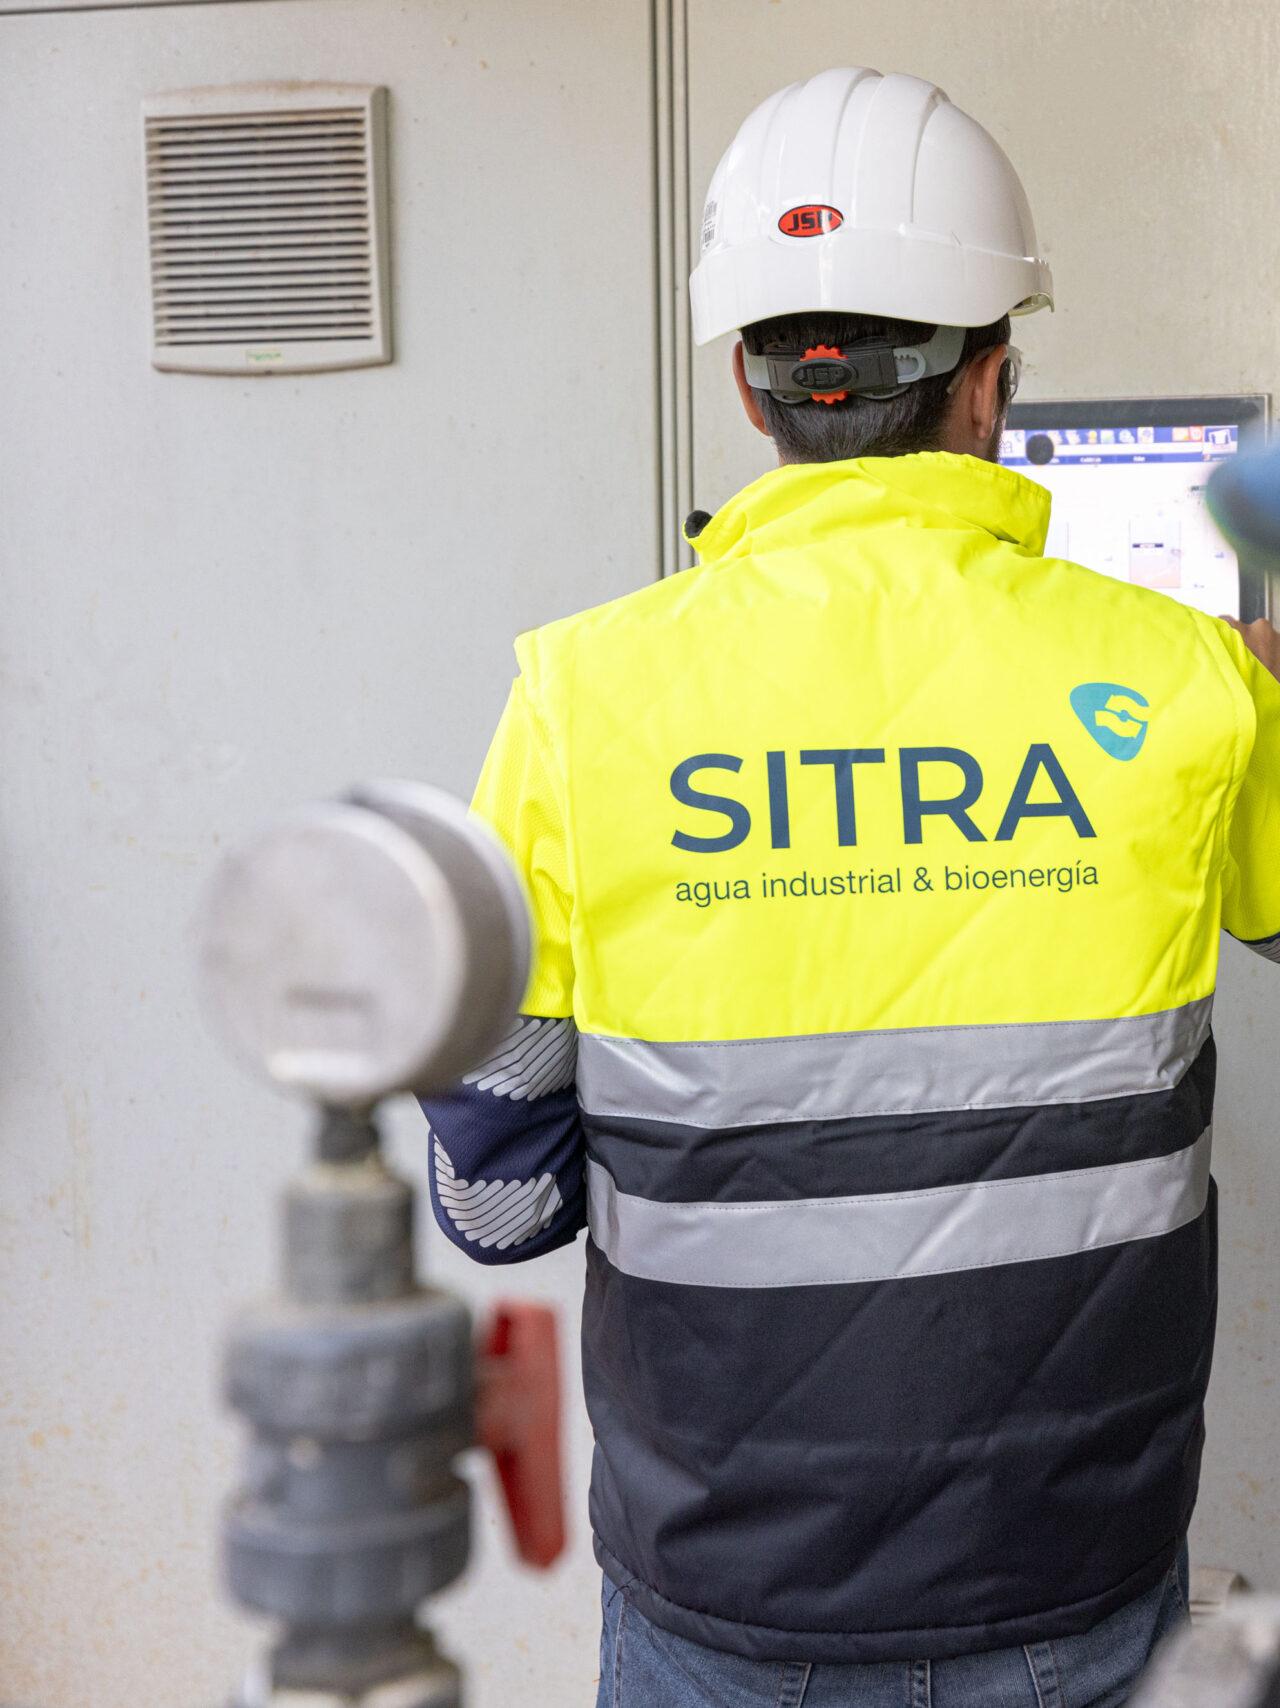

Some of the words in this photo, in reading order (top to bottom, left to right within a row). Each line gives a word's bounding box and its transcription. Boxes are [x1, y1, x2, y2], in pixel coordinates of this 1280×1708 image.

[800, 365, 846, 387] JSP
[669, 743, 1098, 854] SITRA
[676, 879, 752, 908] agua
[762, 867, 902, 898] industrial
[913, 866, 935, 892] &
[945, 860, 1099, 892] bioenergía
